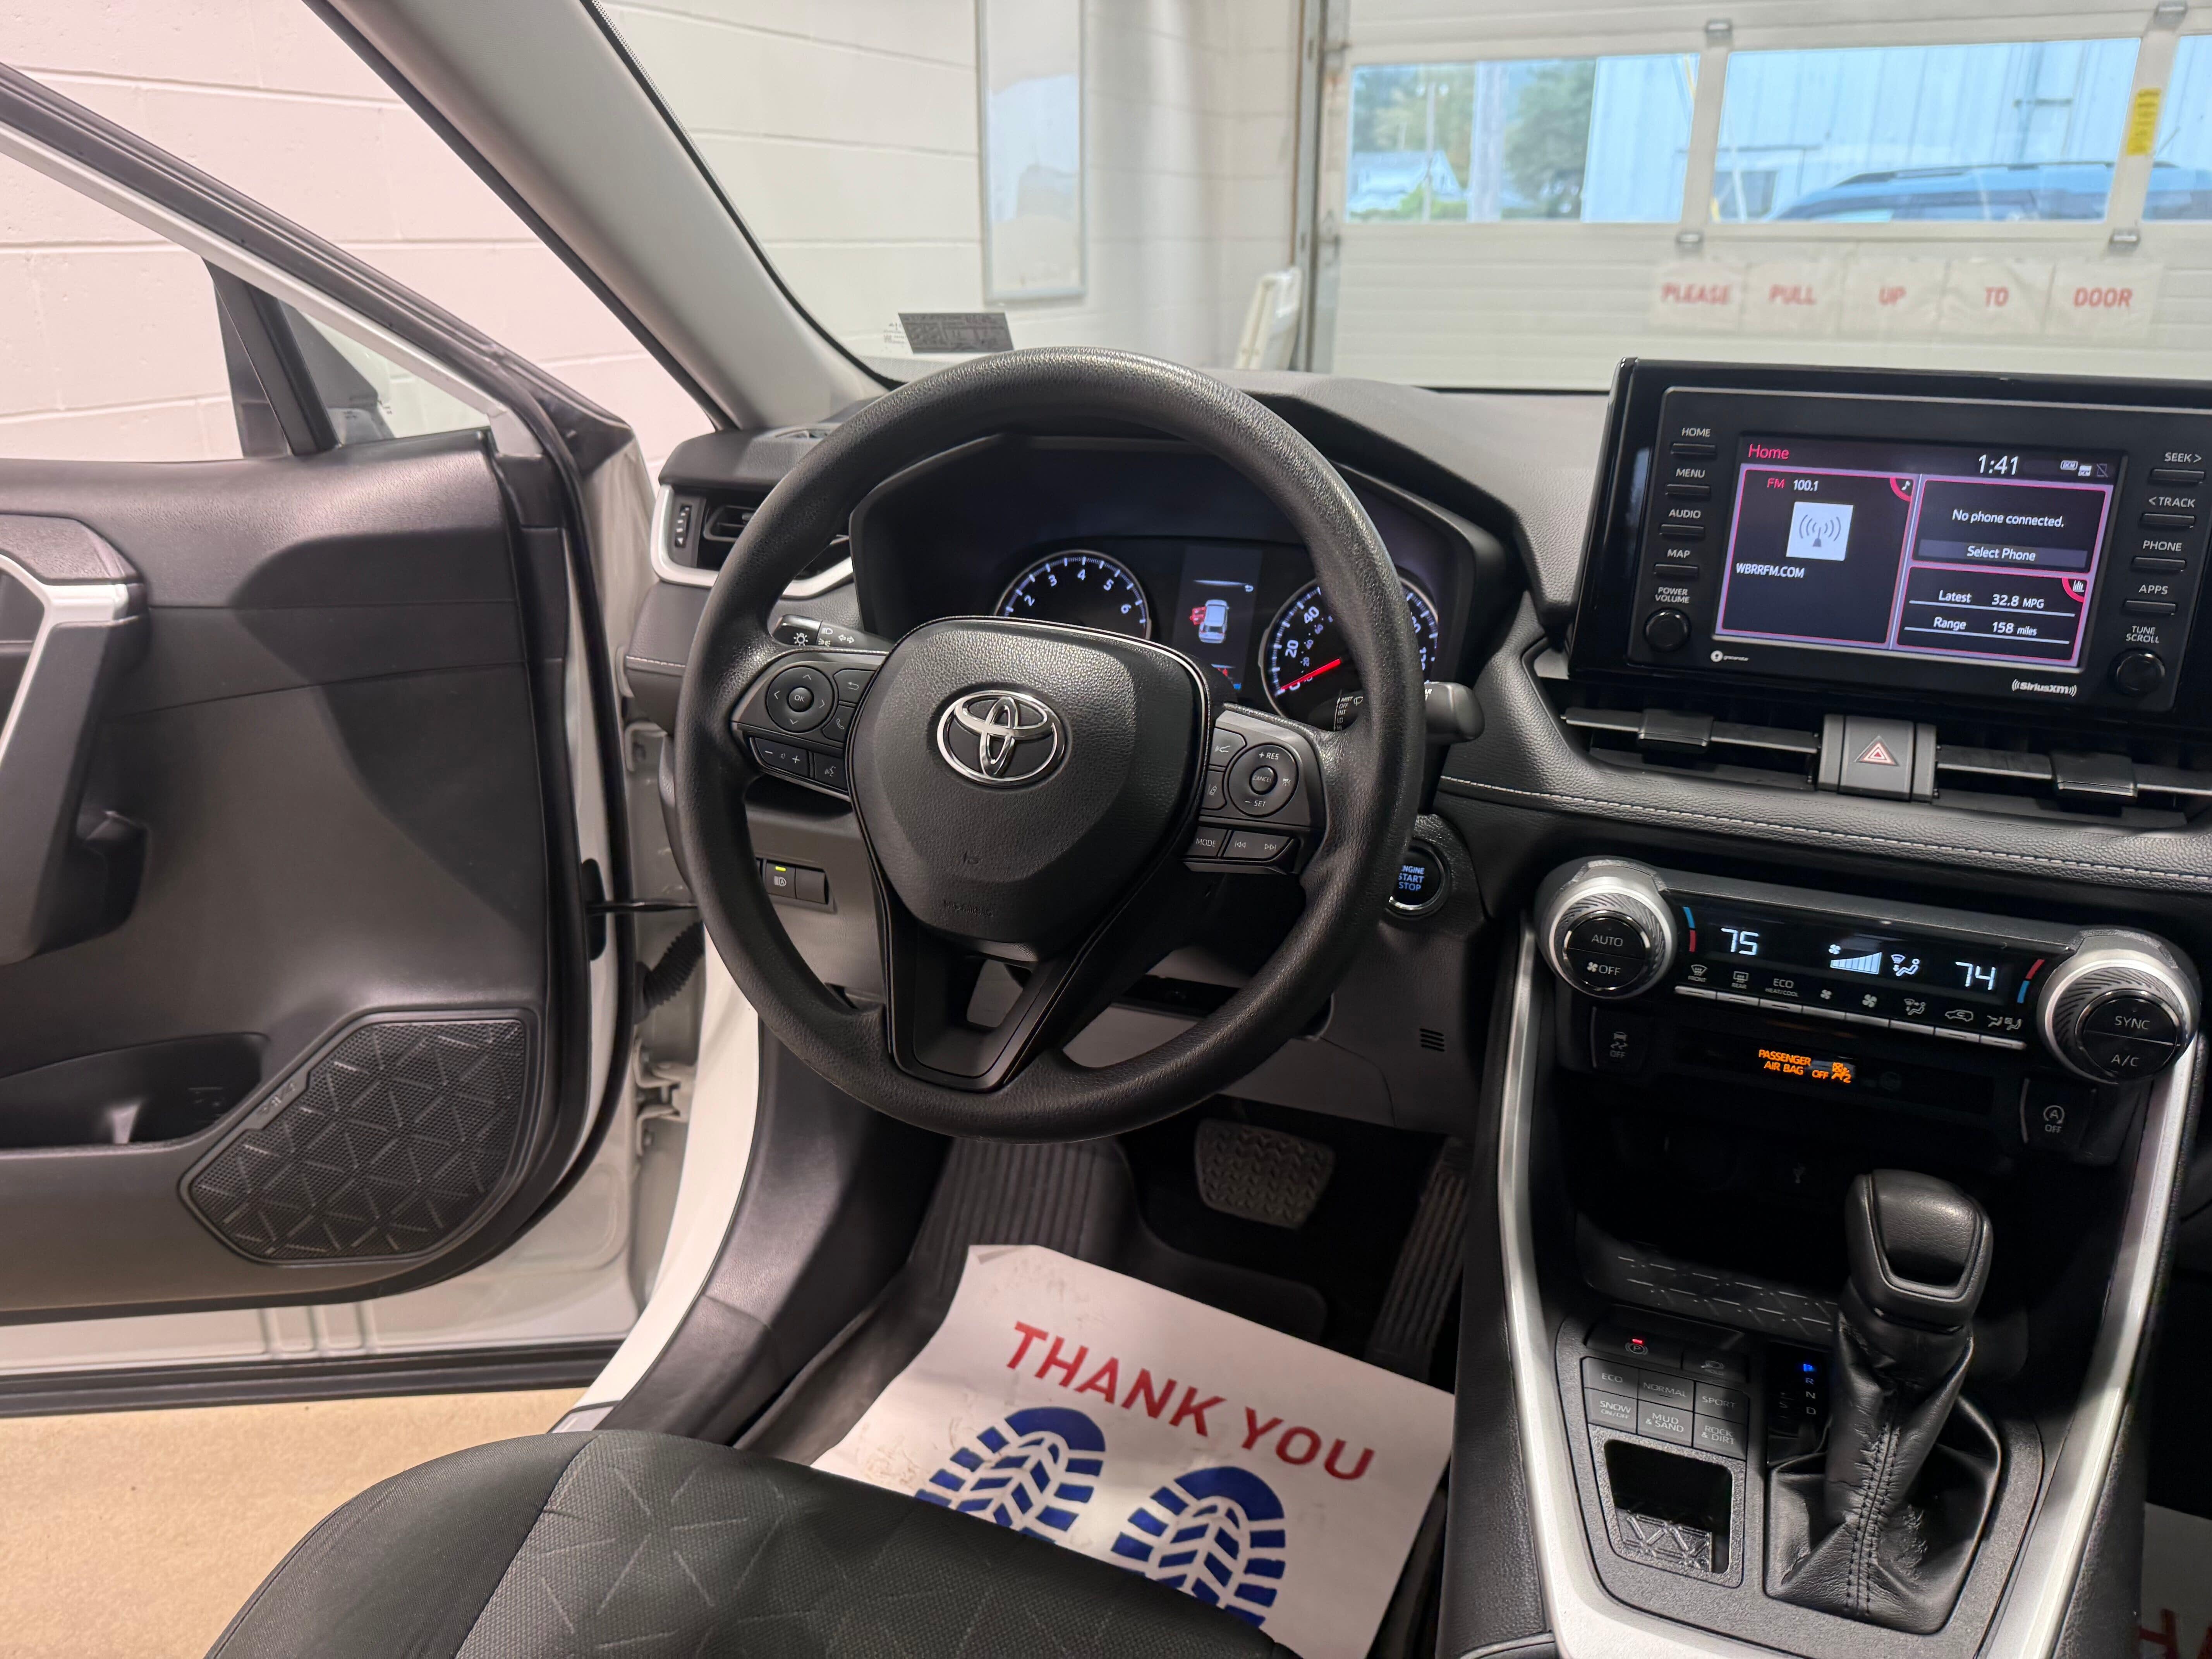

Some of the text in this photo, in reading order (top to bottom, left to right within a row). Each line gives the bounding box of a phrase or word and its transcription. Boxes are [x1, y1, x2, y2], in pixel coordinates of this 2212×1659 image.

[1662, 283, 2133, 308] PLEASE PULL UP TO DOOR
[1682, 428, 1711, 437] HOME
[1748, 444, 1790, 460] Home
[2164, 452, 2192, 463] SEEK
[1978, 454, 2020, 475] 1:41
[1676, 469, 1705, 479] MENU
[1767, 478, 1819, 491] FM 100.1
[2157, 496, 2196, 508] TRACK
[1668, 509, 1701, 519] AUDIO
[1952, 509, 2064, 527] No phone connected.
[2143, 540, 2182, 552] PHONE
[1667, 549, 1690, 558] MAP
[1967, 545, 2036, 562] Select Phone
[1077, 569, 1086, 580] 4
[1736, 563, 1805, 579] WBRRFM.COM
[1048, 575, 1058, 587] 3
[1103, 579, 1114, 591] 5
[1658, 587, 1688, 596] POWER
[2138, 584, 2169, 595] APPS
[1024, 595, 1035, 606] 2
[1655, 594, 1690, 604] VOLUME
[1938, 590, 2045, 609] Latest 32.8 MPG
[1120, 603, 1132, 614] 6
[1304, 606, 1320, 624] 40
[1934, 617, 2037, 636] Range 158 miles
[2131, 625, 2156, 635] TUNE
[2125, 634, 2160, 644] SCROLL
[1285, 640, 1299, 658] 20
[1196, 838, 1216, 847] MODE
[1401, 865, 1425, 875] NGINE
[1398, 872, 1425, 883] START
[1399, 881, 1422, 891] STOP
[1591, 934, 1624, 947] AUTO
[1721, 928, 1760, 956] 75
[1599, 965, 1621, 976] OFF
[1955, 961, 1997, 991] 74
[1773, 978, 1794, 989] ECO
[1765, 987, 1800, 997] HEAT/COOL
[2114, 1016, 2150, 1030] SYNC
[1609, 1050, 1626, 1058] OFF
[1759, 1049, 1811, 1066] PASSENGER
[2111, 1054, 2140, 1067] A/C
[1763, 1061, 1804, 1075] AIR BAG
[1811, 1070, 1829, 1079] OFF
[2045, 1125, 2062, 1133] OFF
[1601, 1373, 1623, 1383] ECO
[1643, 1382, 1686, 1397] NORMAL
[1805, 1391, 1816, 1399] N
[1006, 1321, 1375, 1481] THANK YOU
[1600, 1400, 1631, 1413] SNOW
[1702, 1396, 1736, 1410] SPORT
[1806, 1406, 1817, 1415] D
[1652, 1413, 1679, 1424] MUD
[1655, 1420, 1684, 1432] SAND
[1705, 1425, 1733, 1437] ROCK
[1711, 1434, 1736, 1444] DIRT
